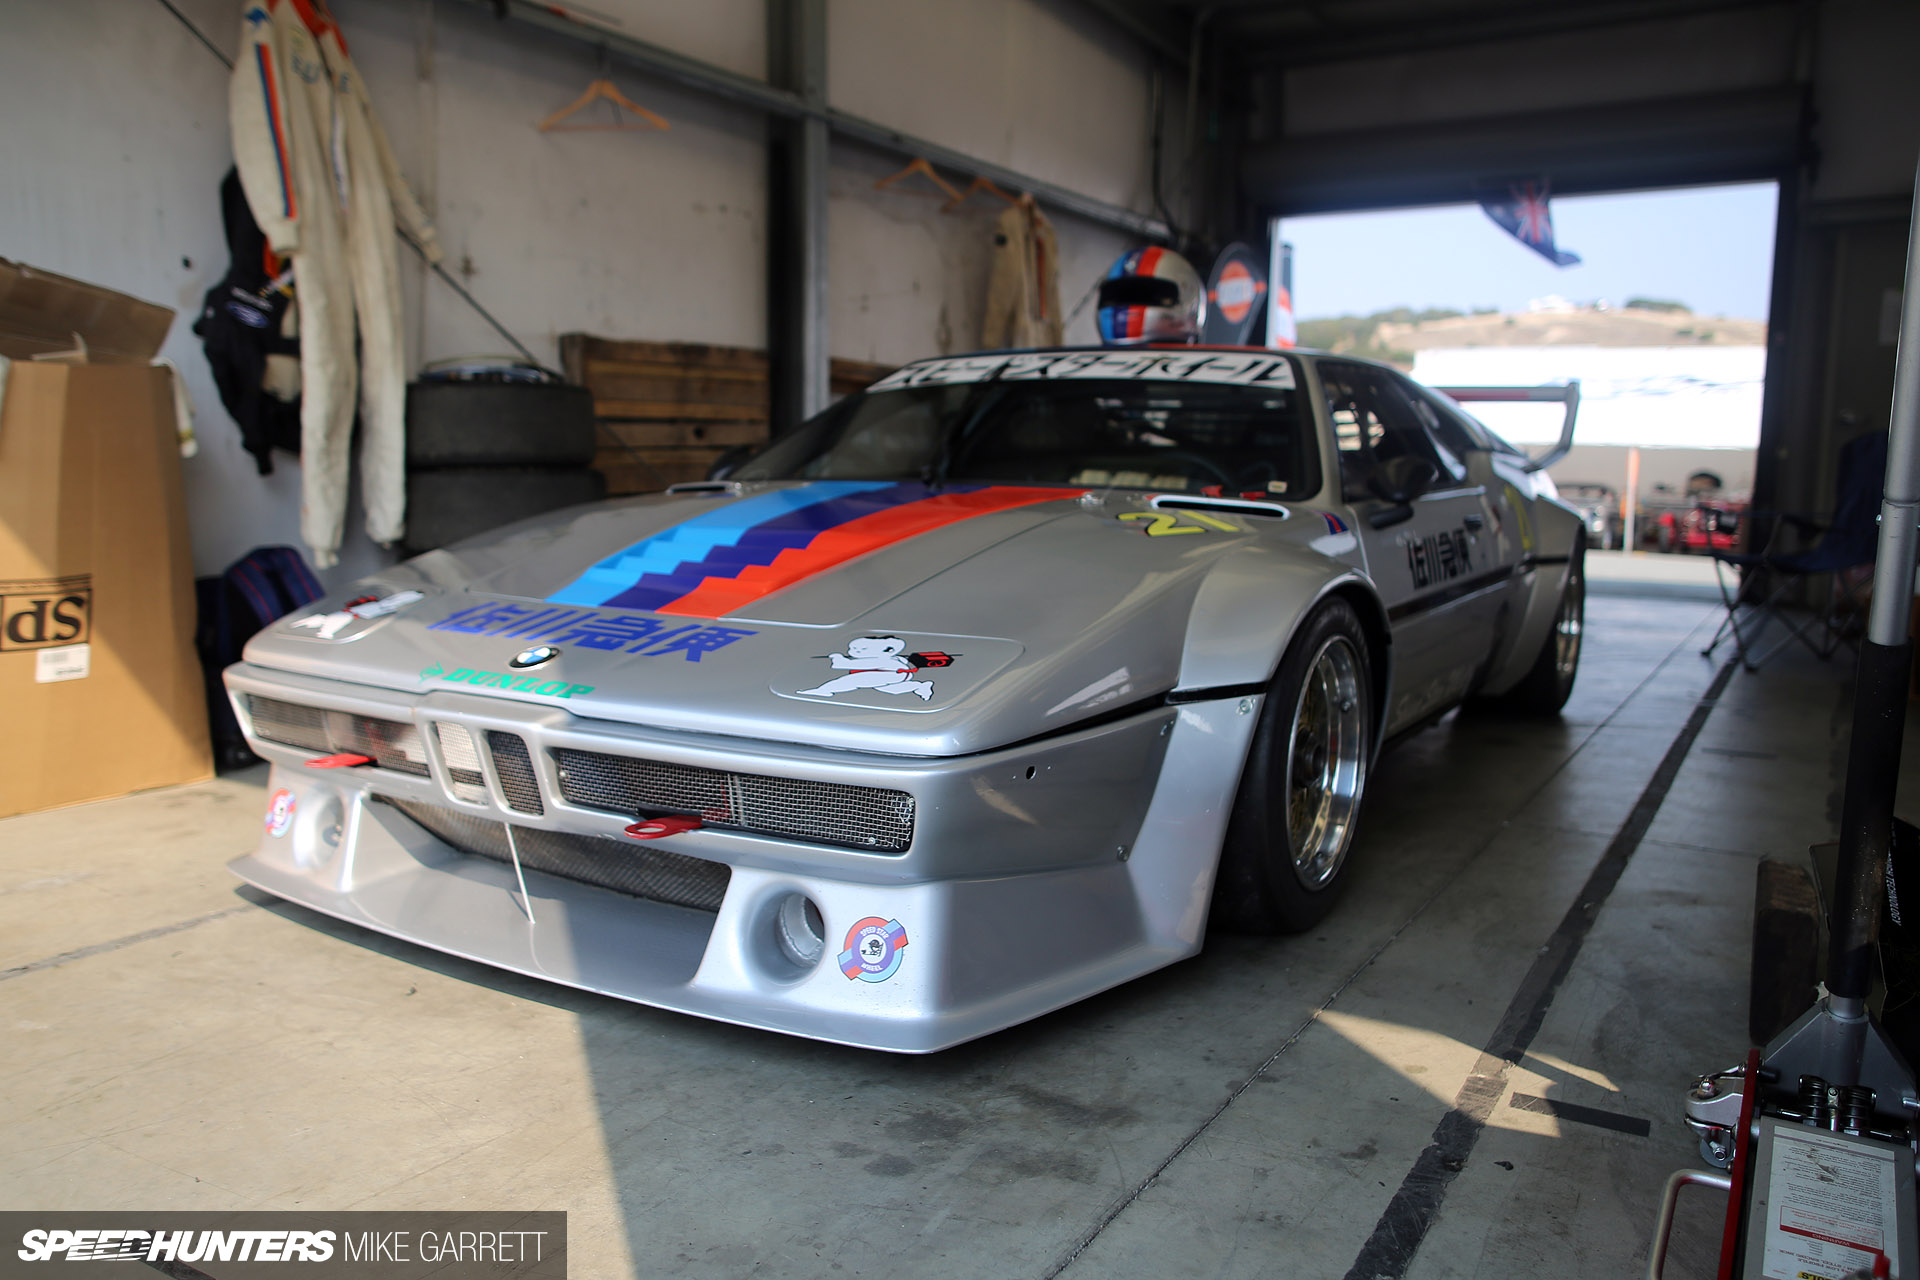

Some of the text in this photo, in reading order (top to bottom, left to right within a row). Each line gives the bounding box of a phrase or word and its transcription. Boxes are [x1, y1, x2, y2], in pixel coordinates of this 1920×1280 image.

[441, 667, 595, 698] DUNLOP
[1886, 876, 1902, 926] TECHNOLOGY
[860, 926, 890, 940] SPEED STAR
[1811, 1233, 1851, 1247] WARNING
